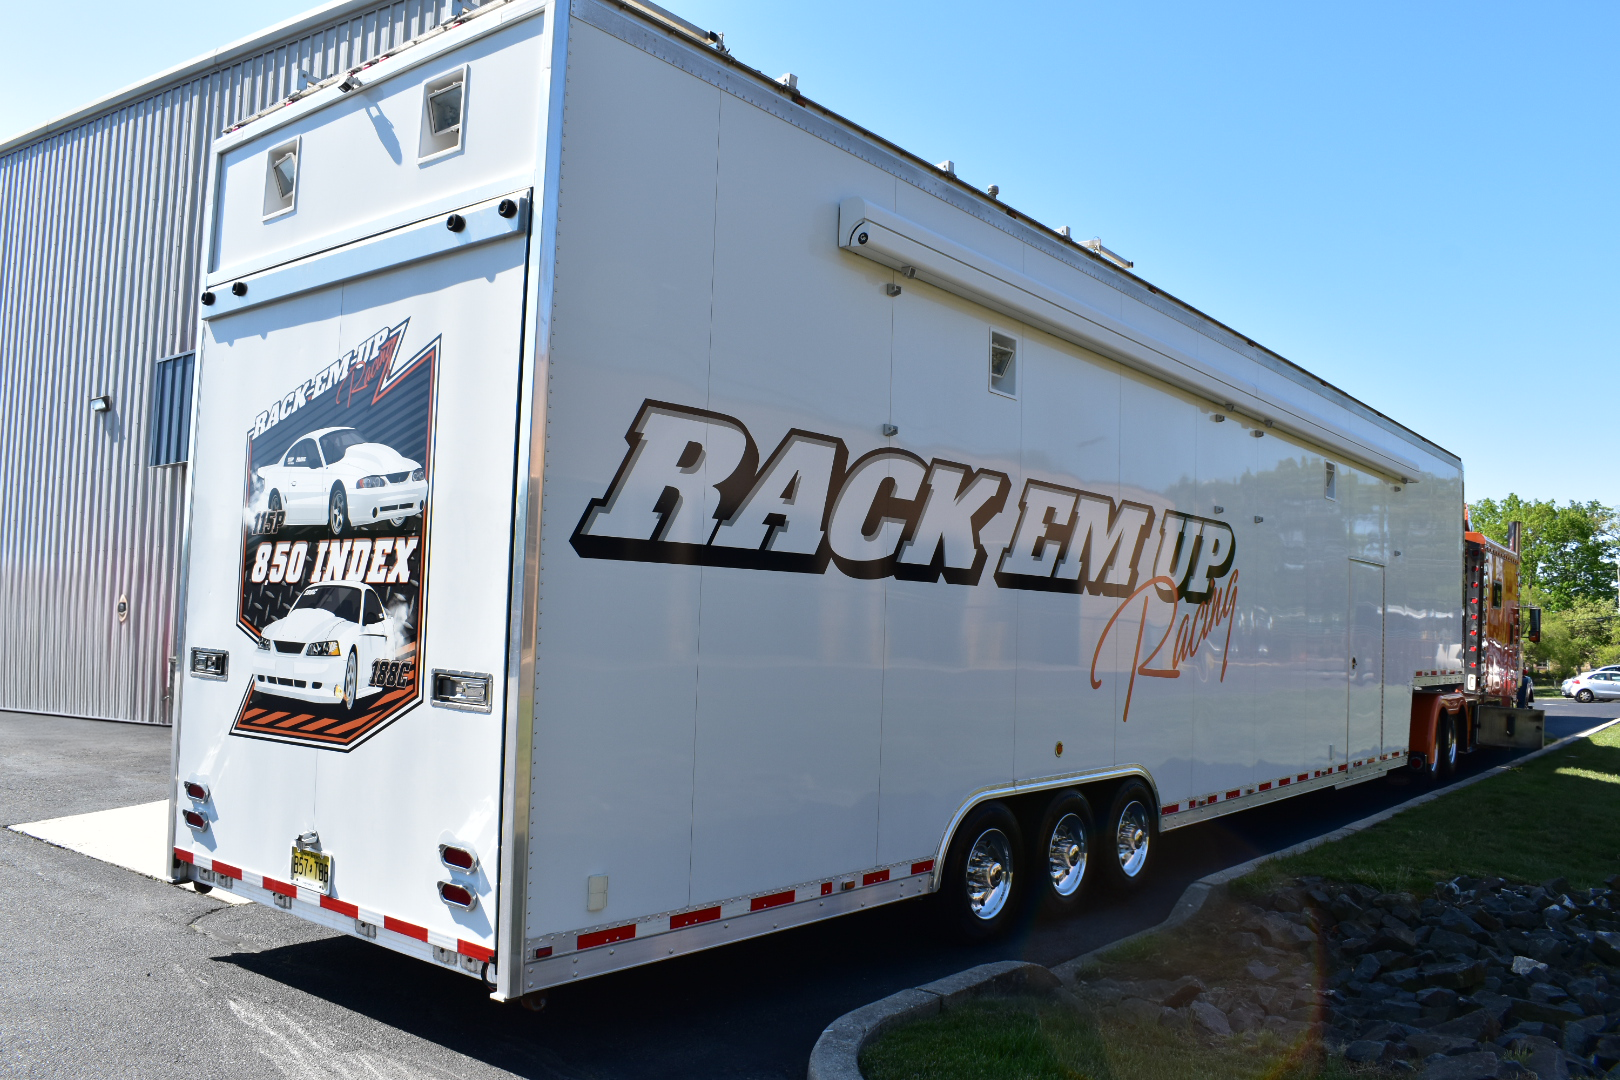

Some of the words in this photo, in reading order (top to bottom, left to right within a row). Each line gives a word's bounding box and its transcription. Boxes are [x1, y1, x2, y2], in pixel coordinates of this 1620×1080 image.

[310, 536, 420, 584] INDEX
[569, 398, 1012, 586] RACK
[994, 478, 1156, 598] EM
[1153, 509, 1236, 604] UP
[1090, 569, 1239, 723] Racing
